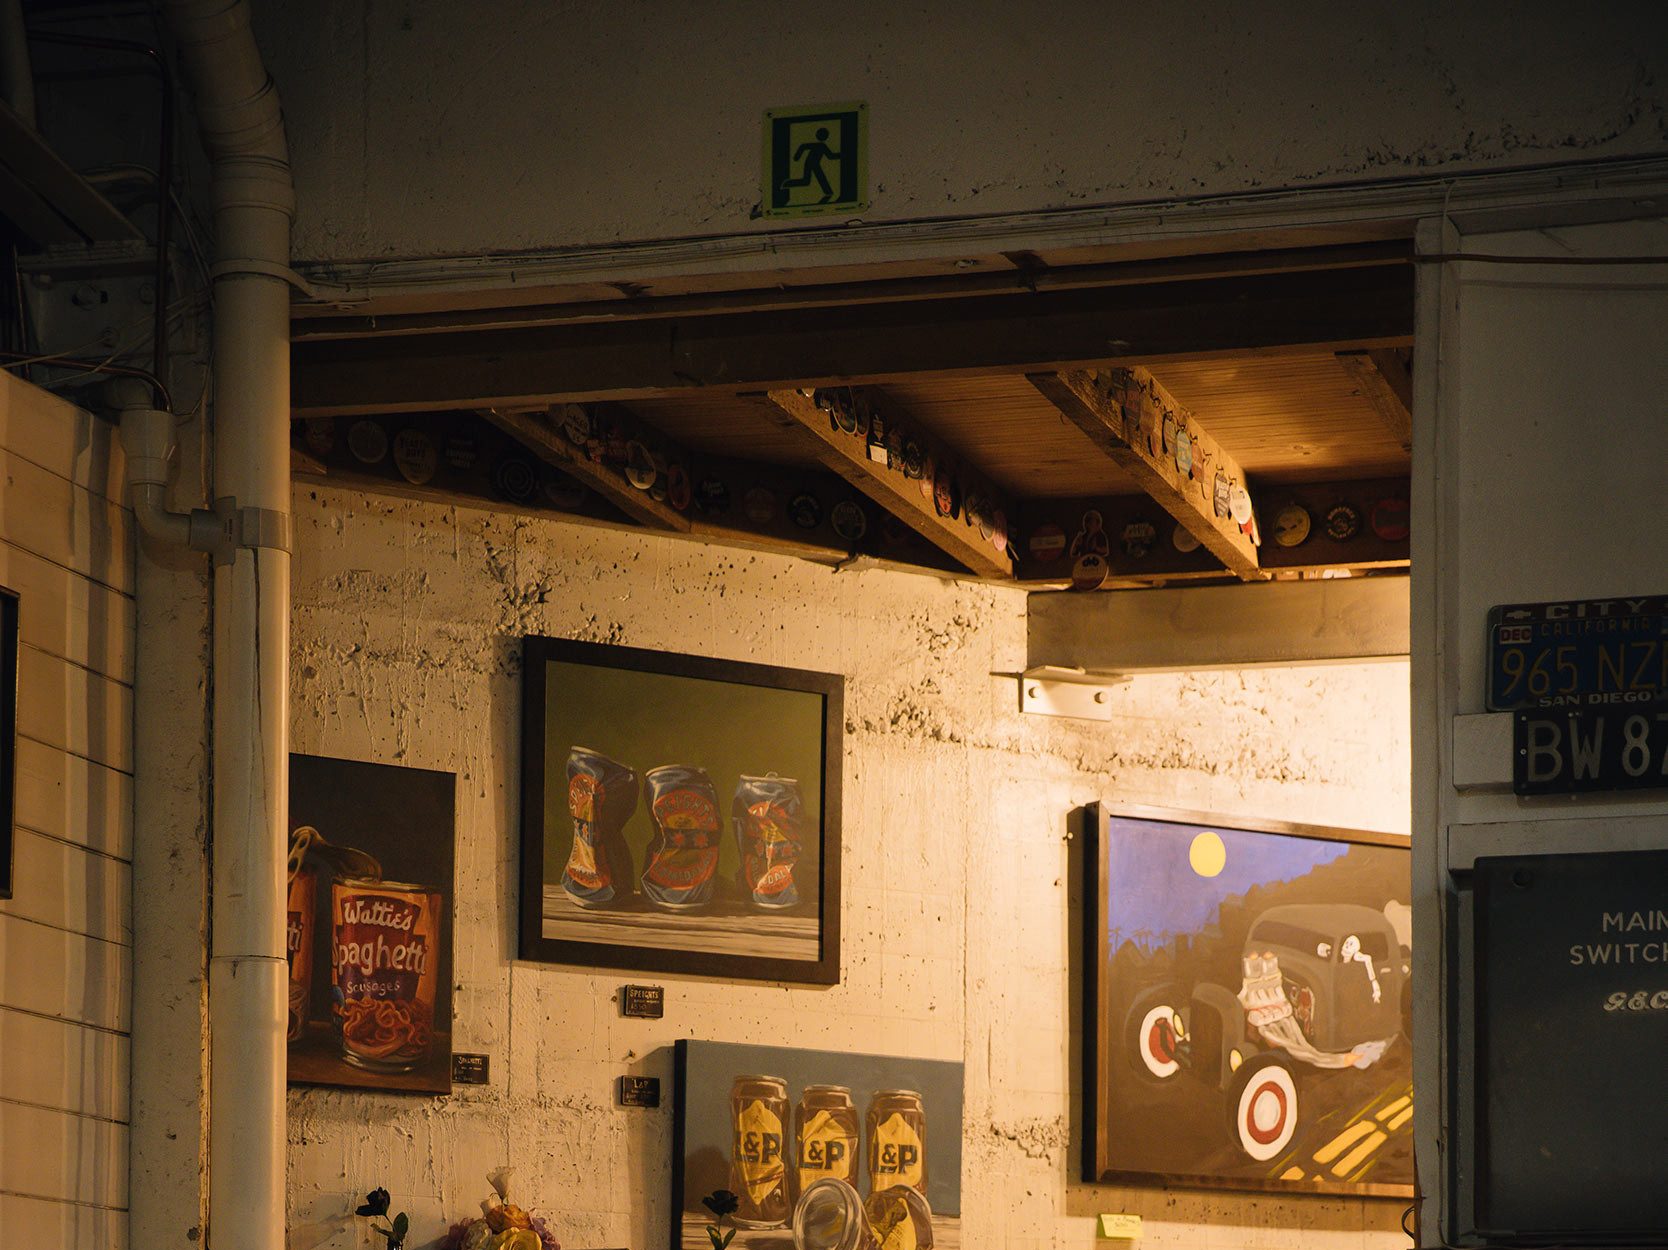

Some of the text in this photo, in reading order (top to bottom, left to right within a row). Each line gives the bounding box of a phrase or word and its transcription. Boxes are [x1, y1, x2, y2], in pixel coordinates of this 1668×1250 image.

[1545, 600, 1648, 620] CITY
[1500, 628, 1532, 642] DEC
[1541, 617, 1649, 637] CALIFORNIA
[1501, 645, 1579, 697] 965
[1539, 690, 1653, 708] SAN DIEGO
[1527, 716, 1605, 783] BW
[344, 900, 412, 931] Wattie's
[333, 934, 428, 976] Spaghetti
